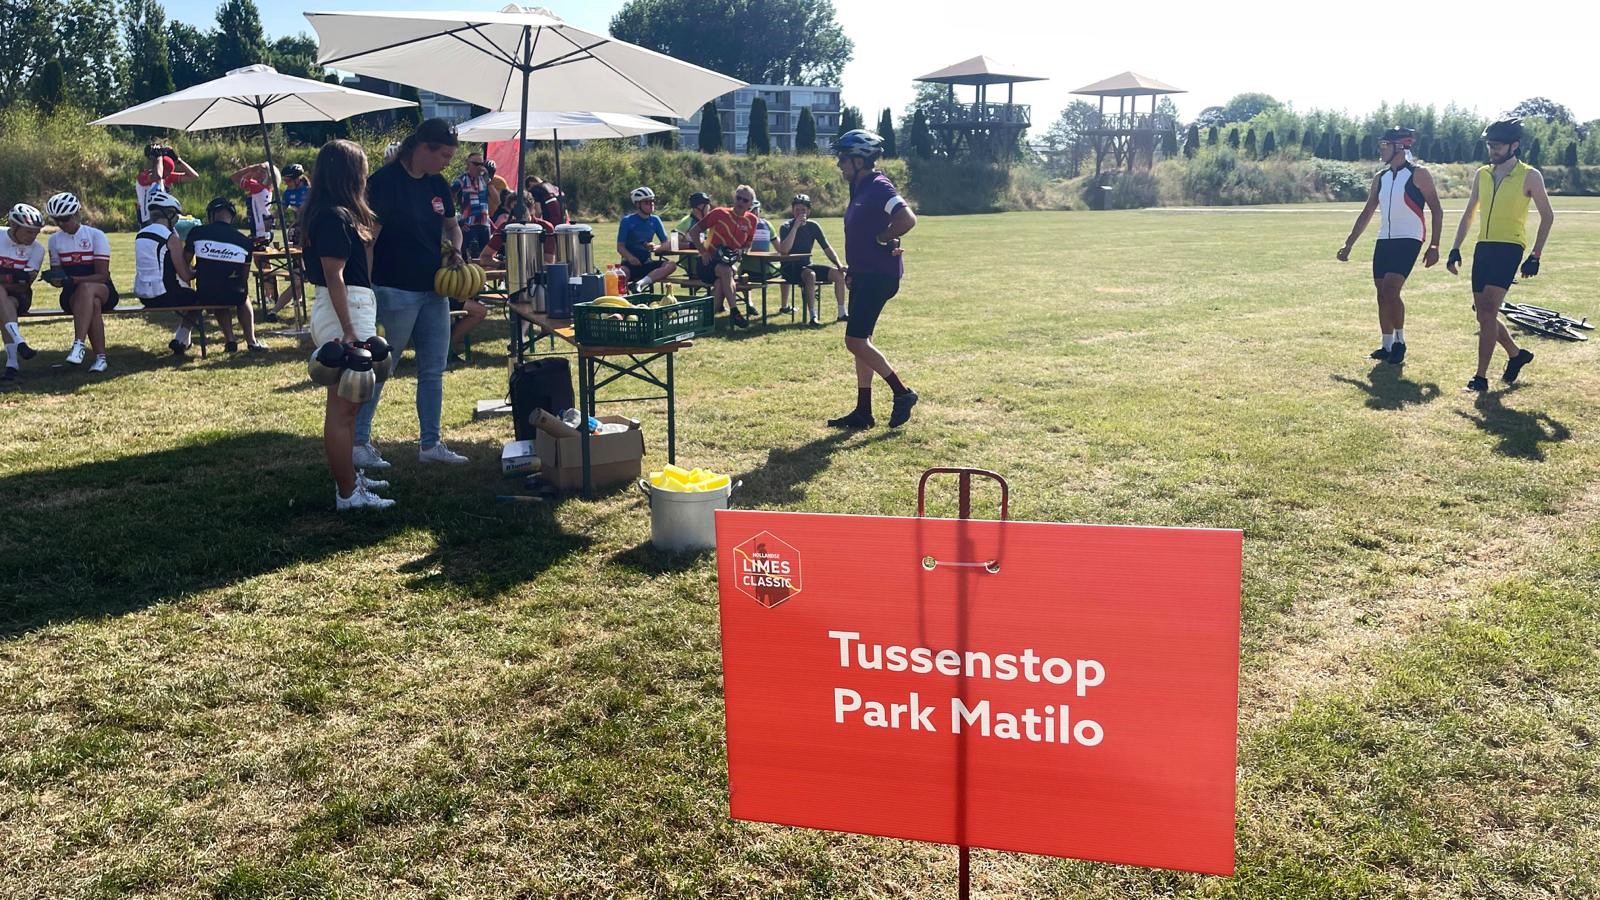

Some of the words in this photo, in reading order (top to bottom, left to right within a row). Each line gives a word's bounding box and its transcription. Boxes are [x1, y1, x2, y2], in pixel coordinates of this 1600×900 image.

[743, 559, 790, 574] LIMES
[743, 575, 792, 588] CLASSIC
[829, 630, 1106, 697] Tussenstop
[834, 687, 937, 737] Park
[951, 697, 1104, 747] Matilo
